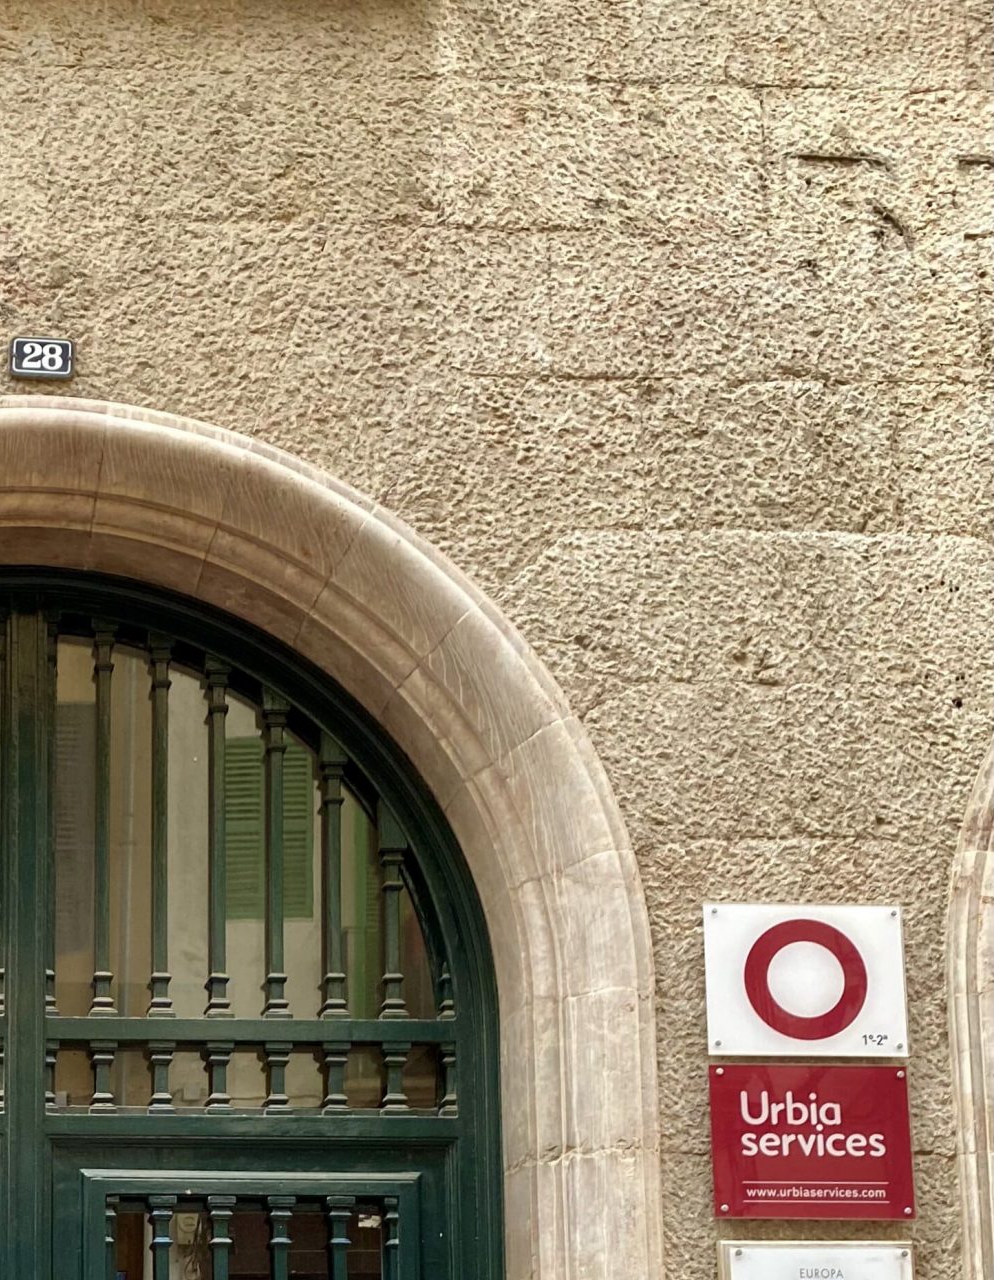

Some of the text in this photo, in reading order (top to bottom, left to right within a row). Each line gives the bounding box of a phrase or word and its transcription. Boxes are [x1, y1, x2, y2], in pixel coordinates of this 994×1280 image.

[22, 342, 63, 371] 28
[740, 1090, 841, 1126] Urbia
[740, 1124, 886, 1157] services
[746, 1186, 886, 1199] www.urbiaservices.com
[799, 1268, 844, 1279] EUROPA
